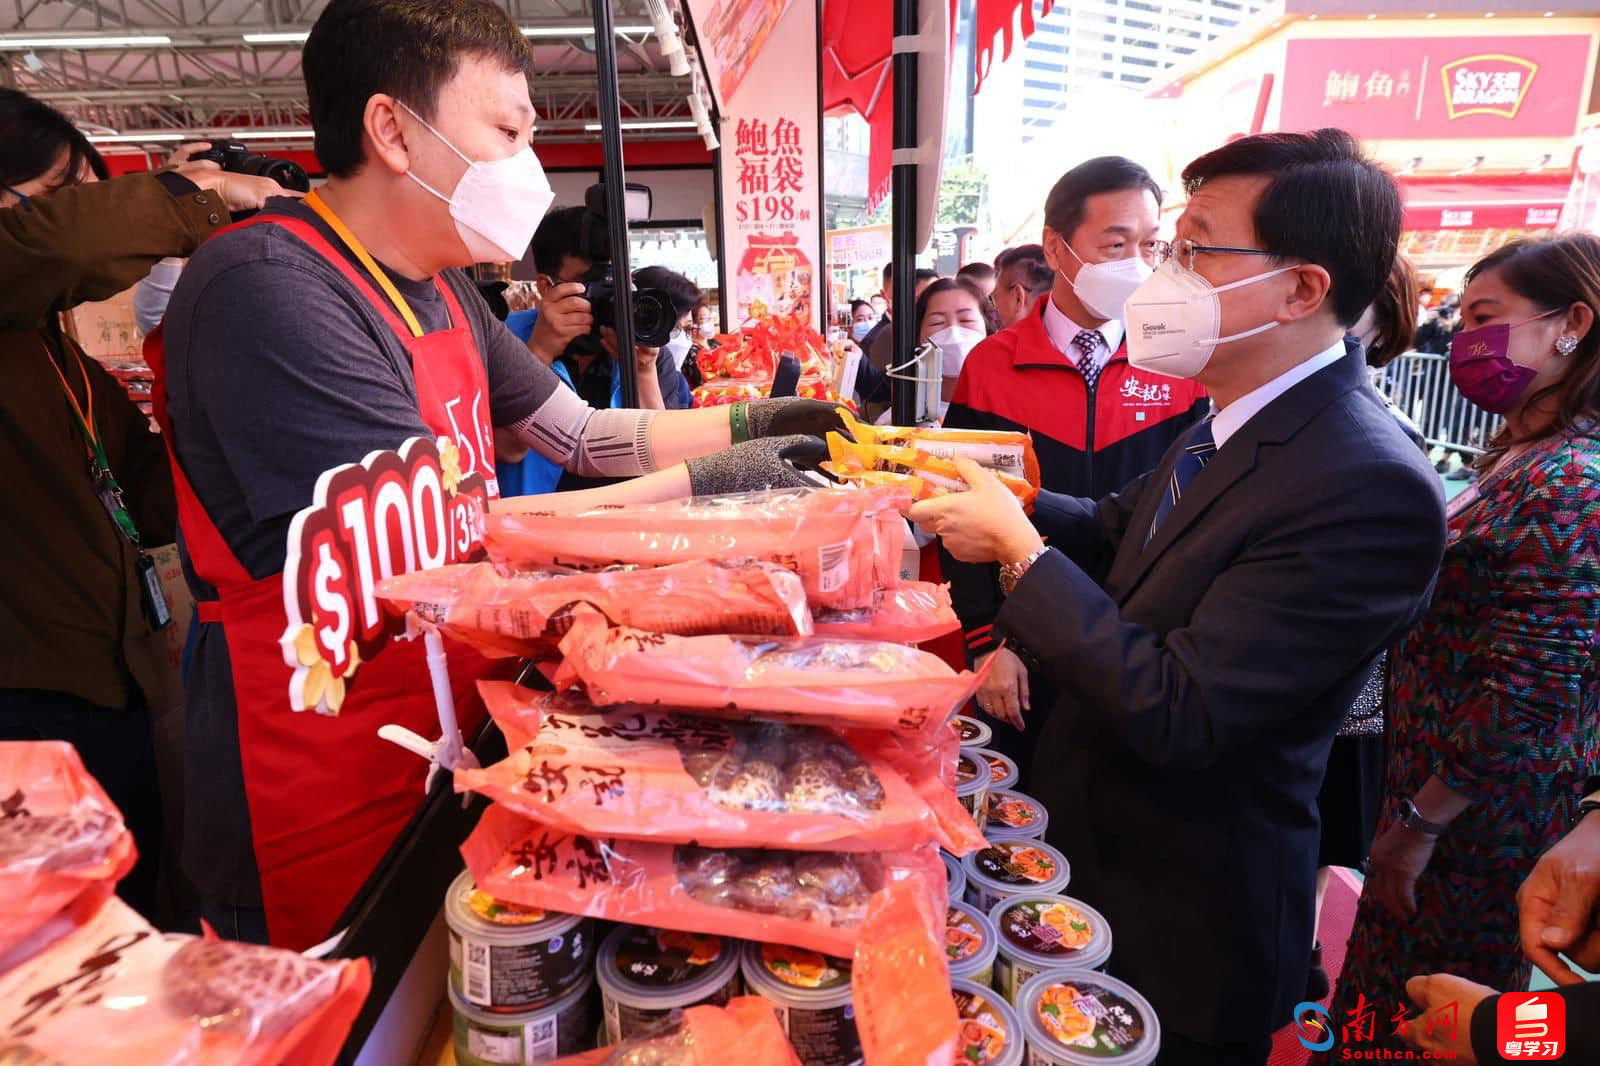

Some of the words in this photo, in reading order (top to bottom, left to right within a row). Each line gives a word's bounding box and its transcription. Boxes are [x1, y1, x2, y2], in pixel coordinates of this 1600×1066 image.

[735, 117, 803, 155] 鮑魚
[736, 156, 804, 194] 福袋
[736, 195, 794, 222] $198
